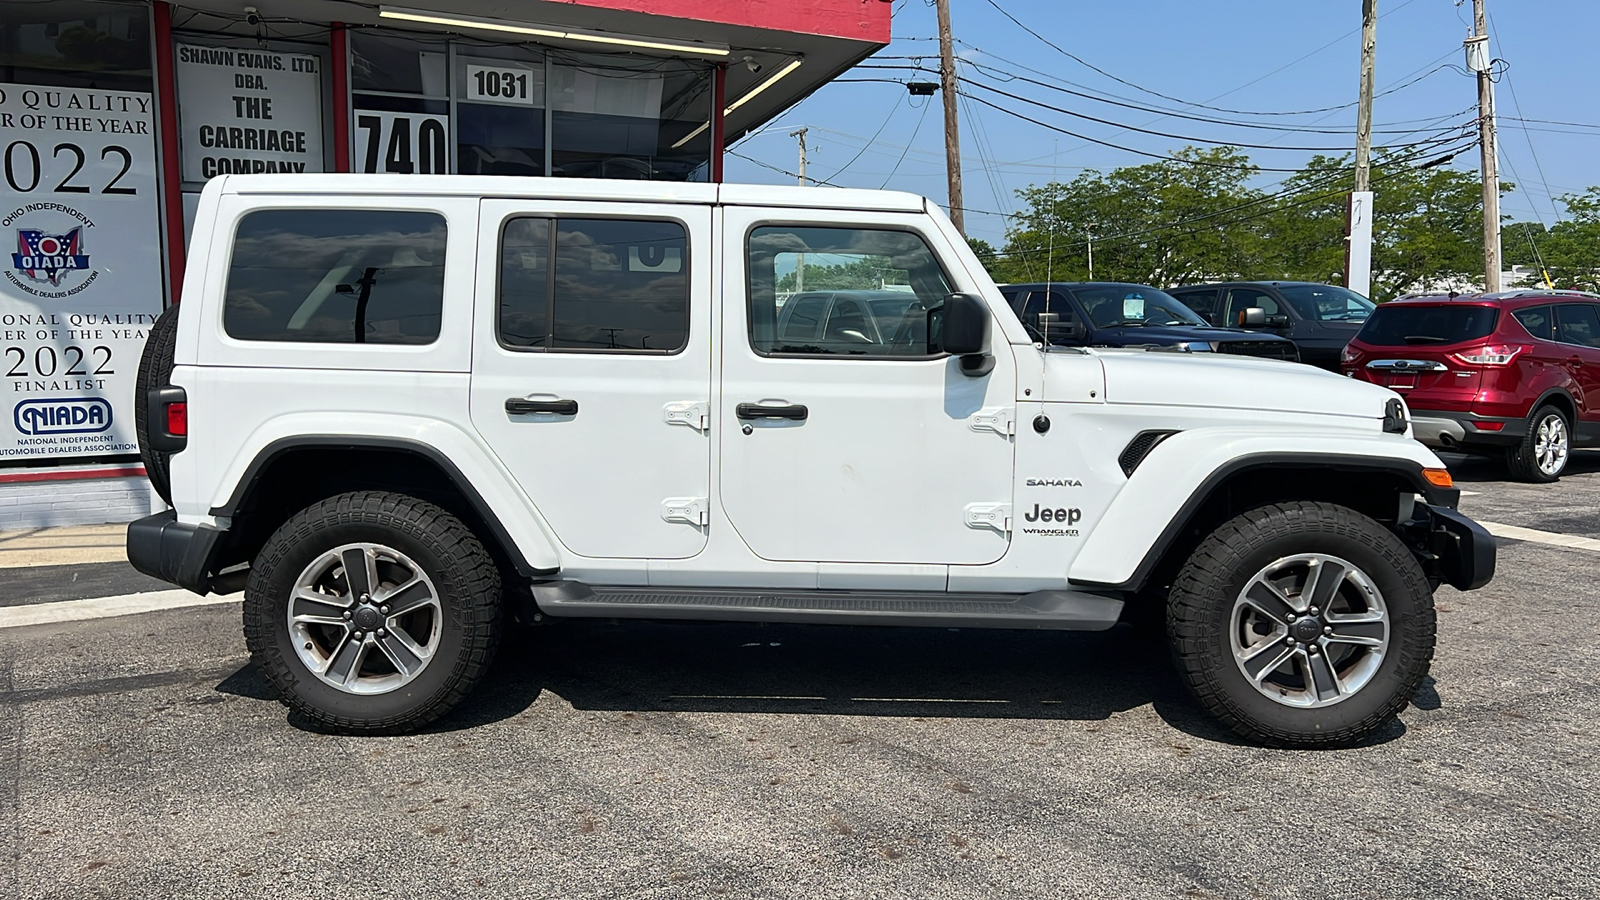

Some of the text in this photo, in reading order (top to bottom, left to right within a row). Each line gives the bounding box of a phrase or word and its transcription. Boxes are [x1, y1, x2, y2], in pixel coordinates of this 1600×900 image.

[179, 48, 318, 74] SHAWN EVANS. LTD.
[234, 73, 268, 91] DBA.
[474, 70, 527, 99] 1031
[22, 90, 150, 114] QUALITY
[232, 95, 273, 120] THE
[20, 114, 47, 129] OF
[52, 116, 92, 132] THE
[97, 118, 149, 135] YEAR
[199, 124, 306, 153] CARRIAGE
[358, 114, 445, 174] 740
[4, 140, 138, 195] 022
[2, 202, 96, 229] OHIO INDEPENDENT
[22, 256, 78, 269] OIADA
[4, 270, 99, 299] AUTOMOBILE DEALERS ASSOCIATION
[2, 314, 158, 327] ONAL QUALITY
[36, 330, 59, 340] OF
[68, 329, 104, 340] THE
[5, 345, 115, 378] 2022
[14, 379, 106, 392] FINALIST
[22, 404, 104, 435] NIADA
[0, 443, 137, 456] UTOMOBILE DEALERS ASSOCIATION
[17, 435, 114, 446] NATIONAL INDEPENDENT
[1026, 479, 1083, 487] SAHARA
[1024, 503, 1082, 526] Jeep
